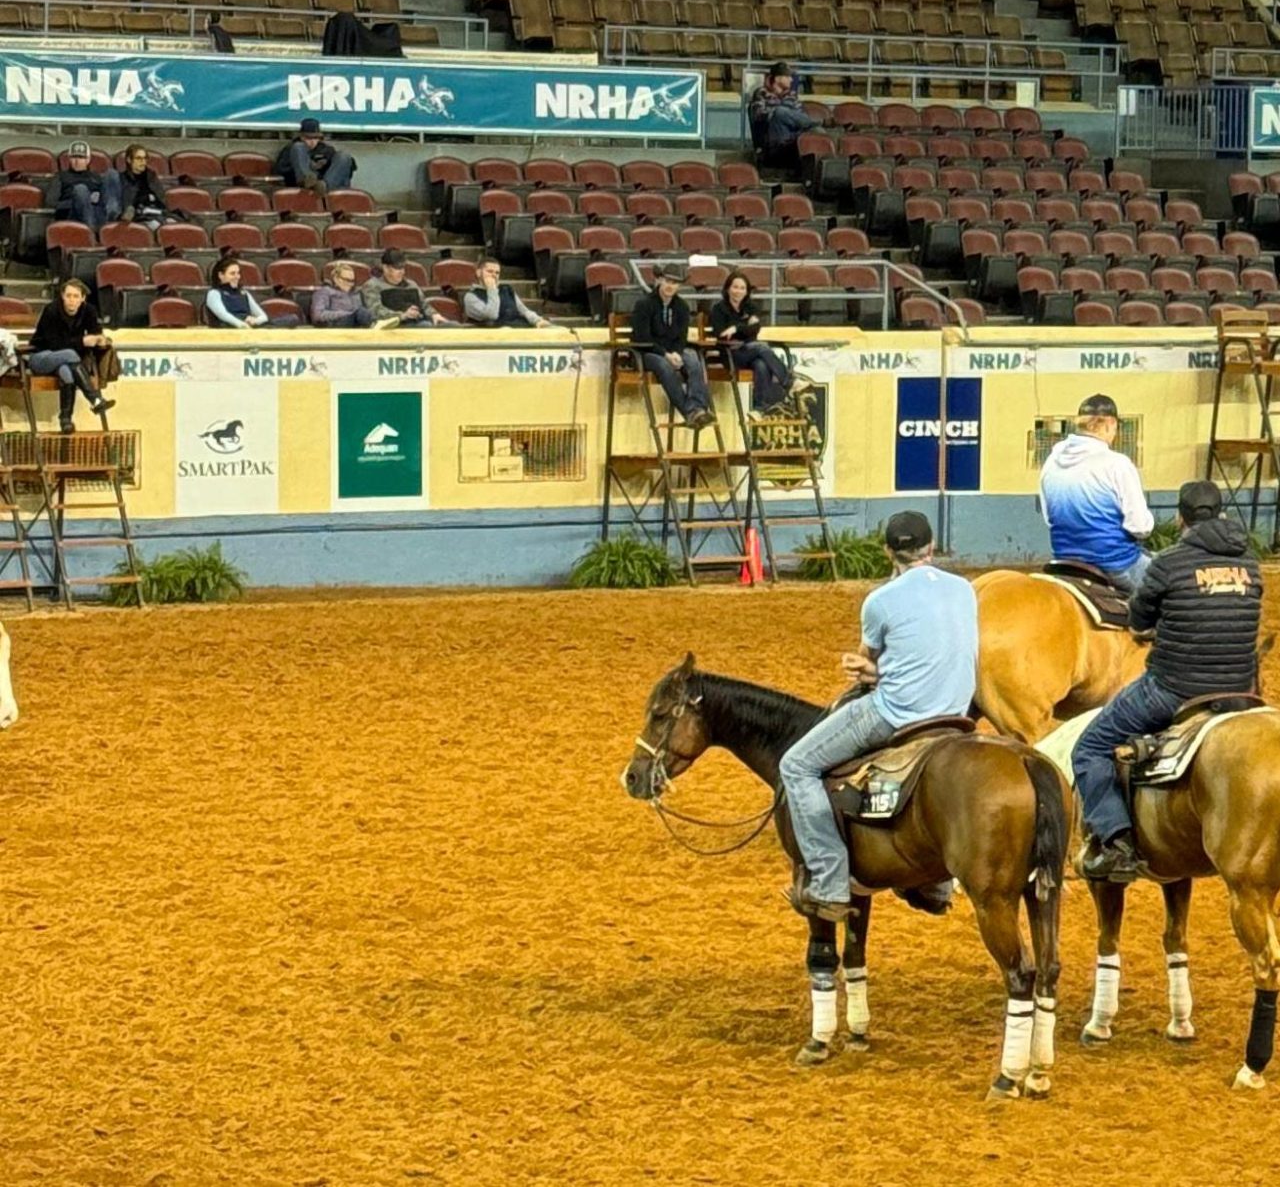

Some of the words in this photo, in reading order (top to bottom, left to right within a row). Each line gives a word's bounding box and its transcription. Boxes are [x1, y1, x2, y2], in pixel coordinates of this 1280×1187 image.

[5, 66, 144, 106] NRHA
[287, 75, 416, 113] NRHA
[535, 82, 656, 120] NRHA
[123, 358, 172, 376] RHA
[243, 359, 308, 376] NRHA
[378, 357, 440, 374] NRHA
[508, 356, 569, 373] NRHA
[969, 352, 1022, 370] NRHA
[1080, 352, 1132, 369] NRHA
[756, 423, 824, 446] NRHA
[898, 419, 979, 438] CINCH
